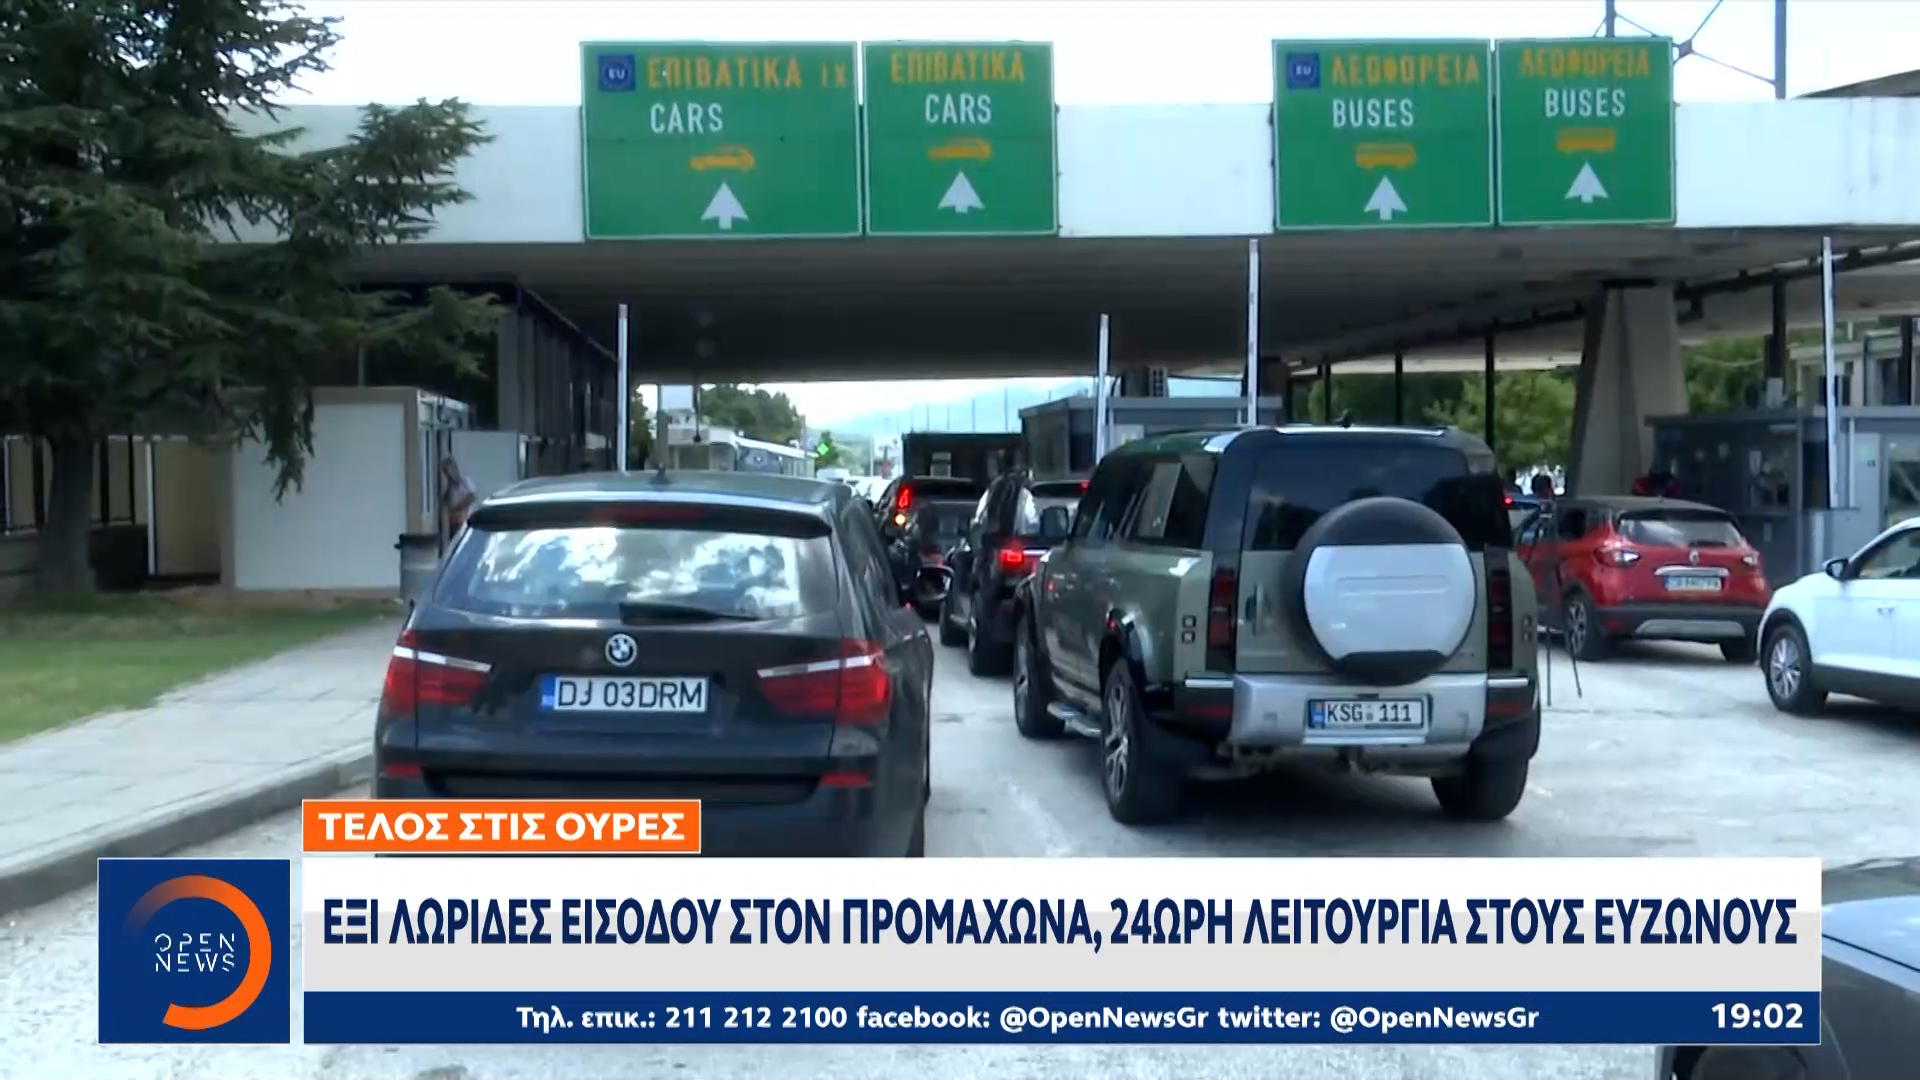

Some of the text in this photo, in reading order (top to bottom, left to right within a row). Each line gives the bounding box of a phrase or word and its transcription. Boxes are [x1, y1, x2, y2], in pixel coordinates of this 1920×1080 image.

[608, 67, 626, 80] EU
[647, 56, 802, 89] ΕΠΙΒΑΤΙΚΑ
[890, 49, 1025, 84] ΕΠΙΒΑΤΙΚΑ
[650, 102, 724, 134] CARS
[924, 93, 992, 125] CARS
[1332, 98, 1415, 128] BUSES
[1544, 87, 1627, 118] BUSES
[557, 680, 703, 708] DJ 03DRM
[1327, 703, 1412, 722] KSG 111
